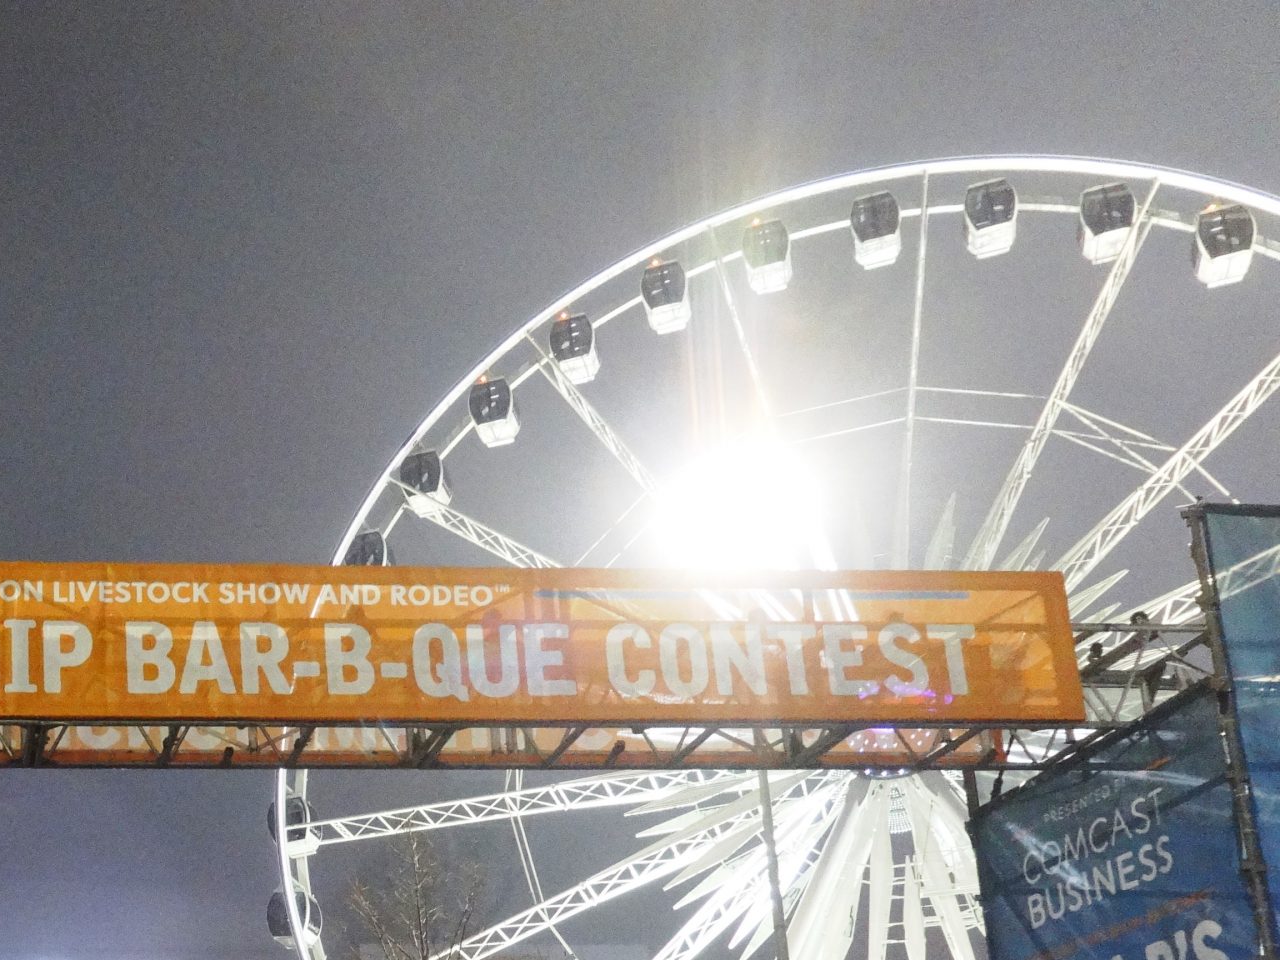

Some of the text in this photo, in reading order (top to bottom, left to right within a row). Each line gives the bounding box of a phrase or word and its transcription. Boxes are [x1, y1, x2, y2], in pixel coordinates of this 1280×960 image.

[53, 580, 208, 605] LIVESTOCK
[219, 582, 310, 605] SHOW
[319, 584, 382, 606] AND
[125, 620, 578, 702] BAR-B-QUE
[605, 622, 976, 698] CONTEST
[1023, 787, 1163, 885] COMCAST
[1028, 835, 1173, 929] BUSINESS
